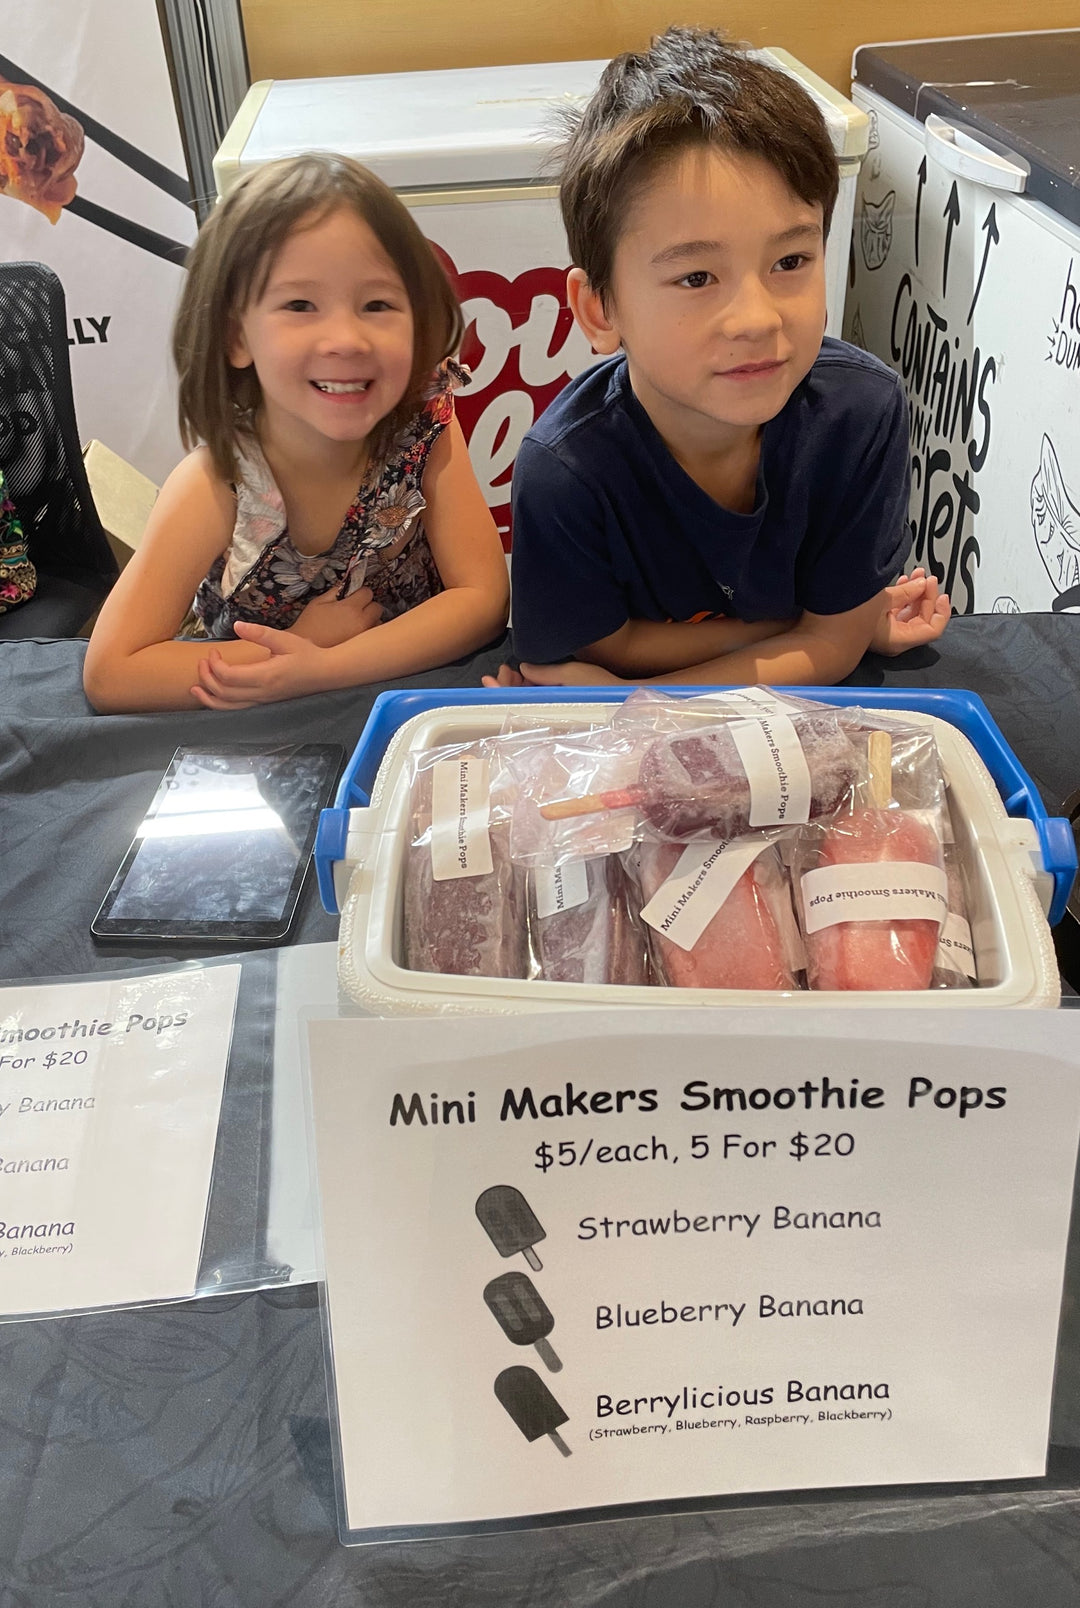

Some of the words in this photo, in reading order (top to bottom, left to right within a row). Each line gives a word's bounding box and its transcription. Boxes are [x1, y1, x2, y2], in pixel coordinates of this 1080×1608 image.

[68, 316, 112, 345] LY
[460, 761, 468, 782] Mini
[771, 748, 789, 792] Smoothie
[460, 783, 468, 816] Makers
[777, 794, 789, 819] Pops
[458, 845, 467, 869] Pops
[555, 884, 564, 910] Mini
[661, 904, 682, 932] Mini
[678, 869, 707, 907] Makers
[703, 837, 731, 870] Smoot
[835, 888, 890, 900] Smoothie
[892, 888, 936, 900] Makers
[809, 894, 833, 907] Pops
[0, 1018, 113, 1045] moothie
[125, 1012, 188, 1035] Pops
[0, 1055, 36, 1070] For
[42, 1050, 88, 1070] $20
[19, 1096, 96, 1113] Banana
[389, 1091, 476, 1126] Mini
[500, 1082, 658, 1121] Makers
[680, 1076, 885, 1112] Smoothie
[908, 1076, 1008, 1118] Pops
[0, 1157, 70, 1174] anana
[534, 1135, 679, 1173] $5/each,
[691, 1135, 710, 1159] 5
[723, 1134, 777, 1159] For
[789, 1131, 856, 1162] $20
[577, 1209, 761, 1241] Strawberry
[773, 1205, 882, 1230] Banana
[11, 1243, 73, 1257] Blackberry)
[596, 1299, 746, 1331] Blueberry
[758, 1295, 864, 1319] Banana
[596, 1385, 774, 1418] Berrylicious
[787, 1380, 890, 1403] Banana
[588, 1422, 672, 1441] (Strawberry,
[676, 1417, 741, 1431] Blueberry,
[745, 1412, 814, 1427] Raspberry,
[818, 1408, 893, 1422] Blackberry)
